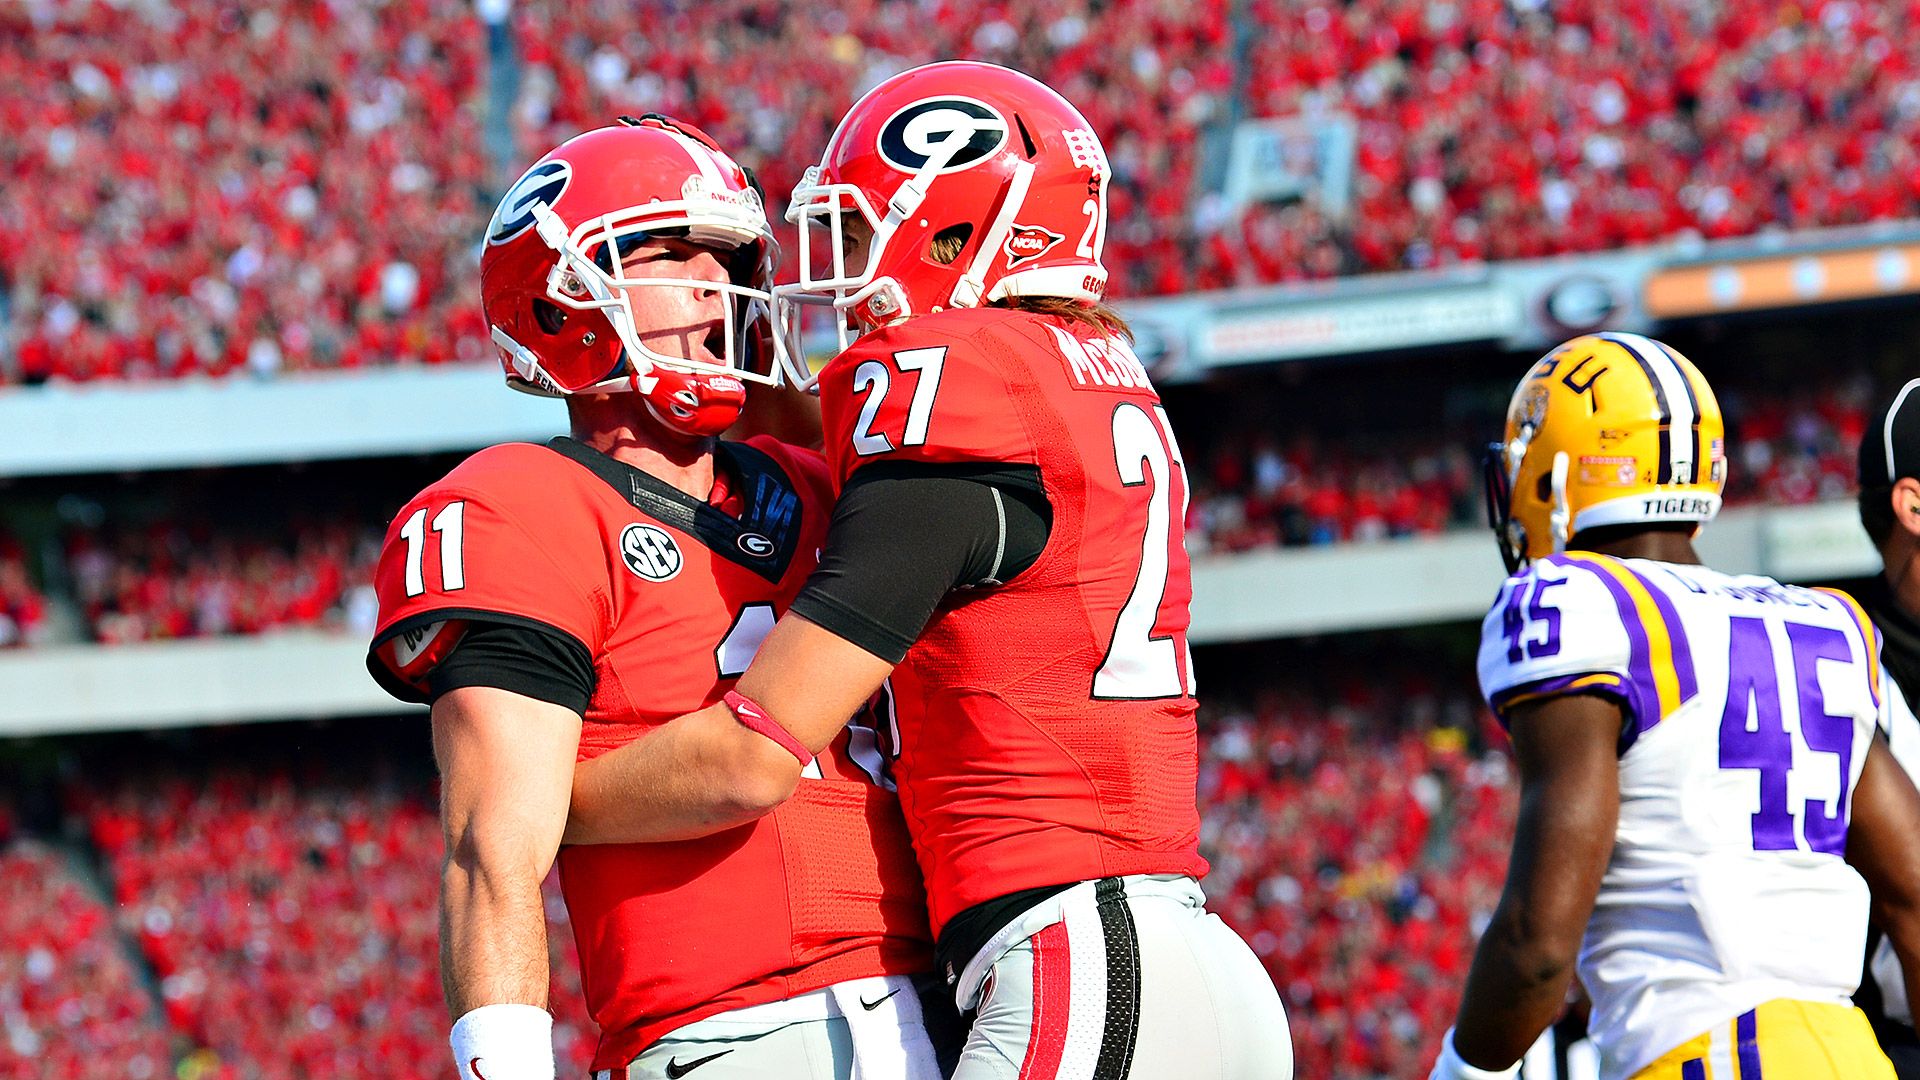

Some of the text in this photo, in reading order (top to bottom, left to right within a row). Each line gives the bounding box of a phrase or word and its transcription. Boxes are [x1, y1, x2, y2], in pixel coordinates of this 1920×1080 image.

[1012, 236, 1044, 250] NCAA
[852, 345, 949, 457] 27
[400, 500, 466, 598] 11
[1643, 498, 1712, 515] TIGERS
[622, 526, 681, 579] SEC
[1502, 577, 1569, 665] 45
[1718, 615, 1854, 858] 45
